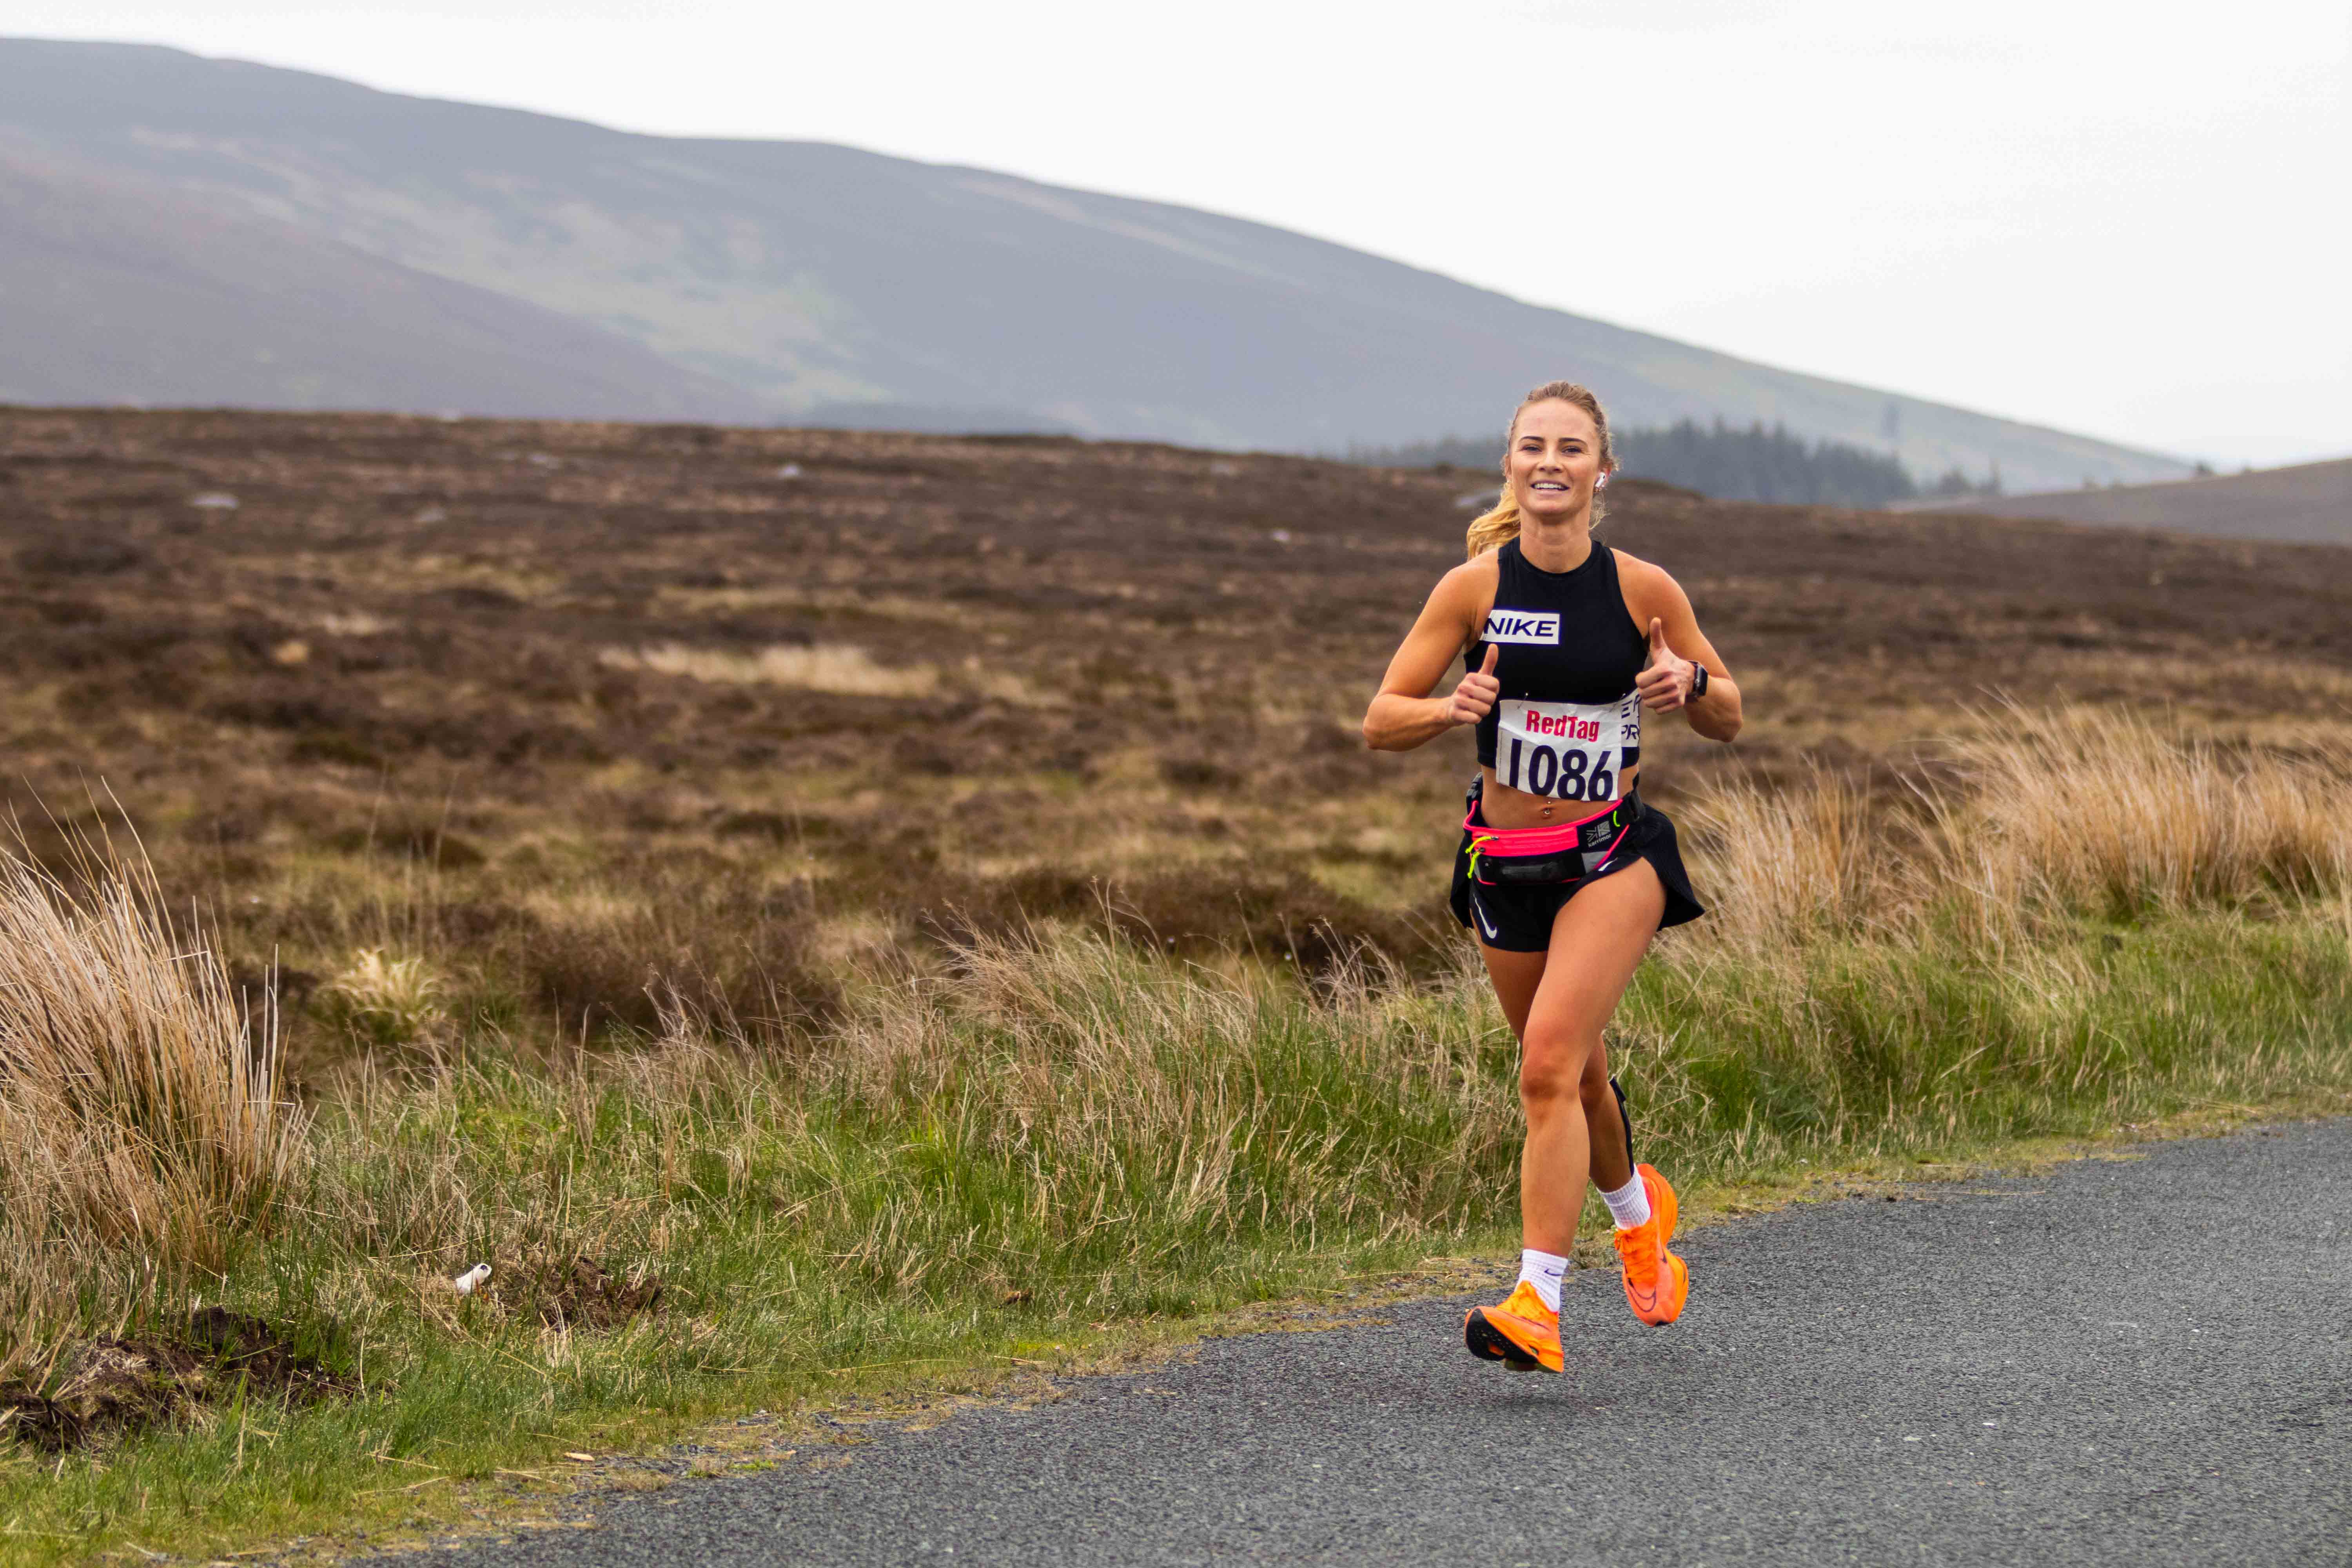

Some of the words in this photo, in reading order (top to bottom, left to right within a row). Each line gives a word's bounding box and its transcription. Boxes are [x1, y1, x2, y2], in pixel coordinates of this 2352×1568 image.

[1483, 618, 1557, 637] NIKE
[1526, 710, 1600, 742] RedTag
[1509, 738, 1613, 801] 1086
[1588, 833, 1612, 848] karrimor
